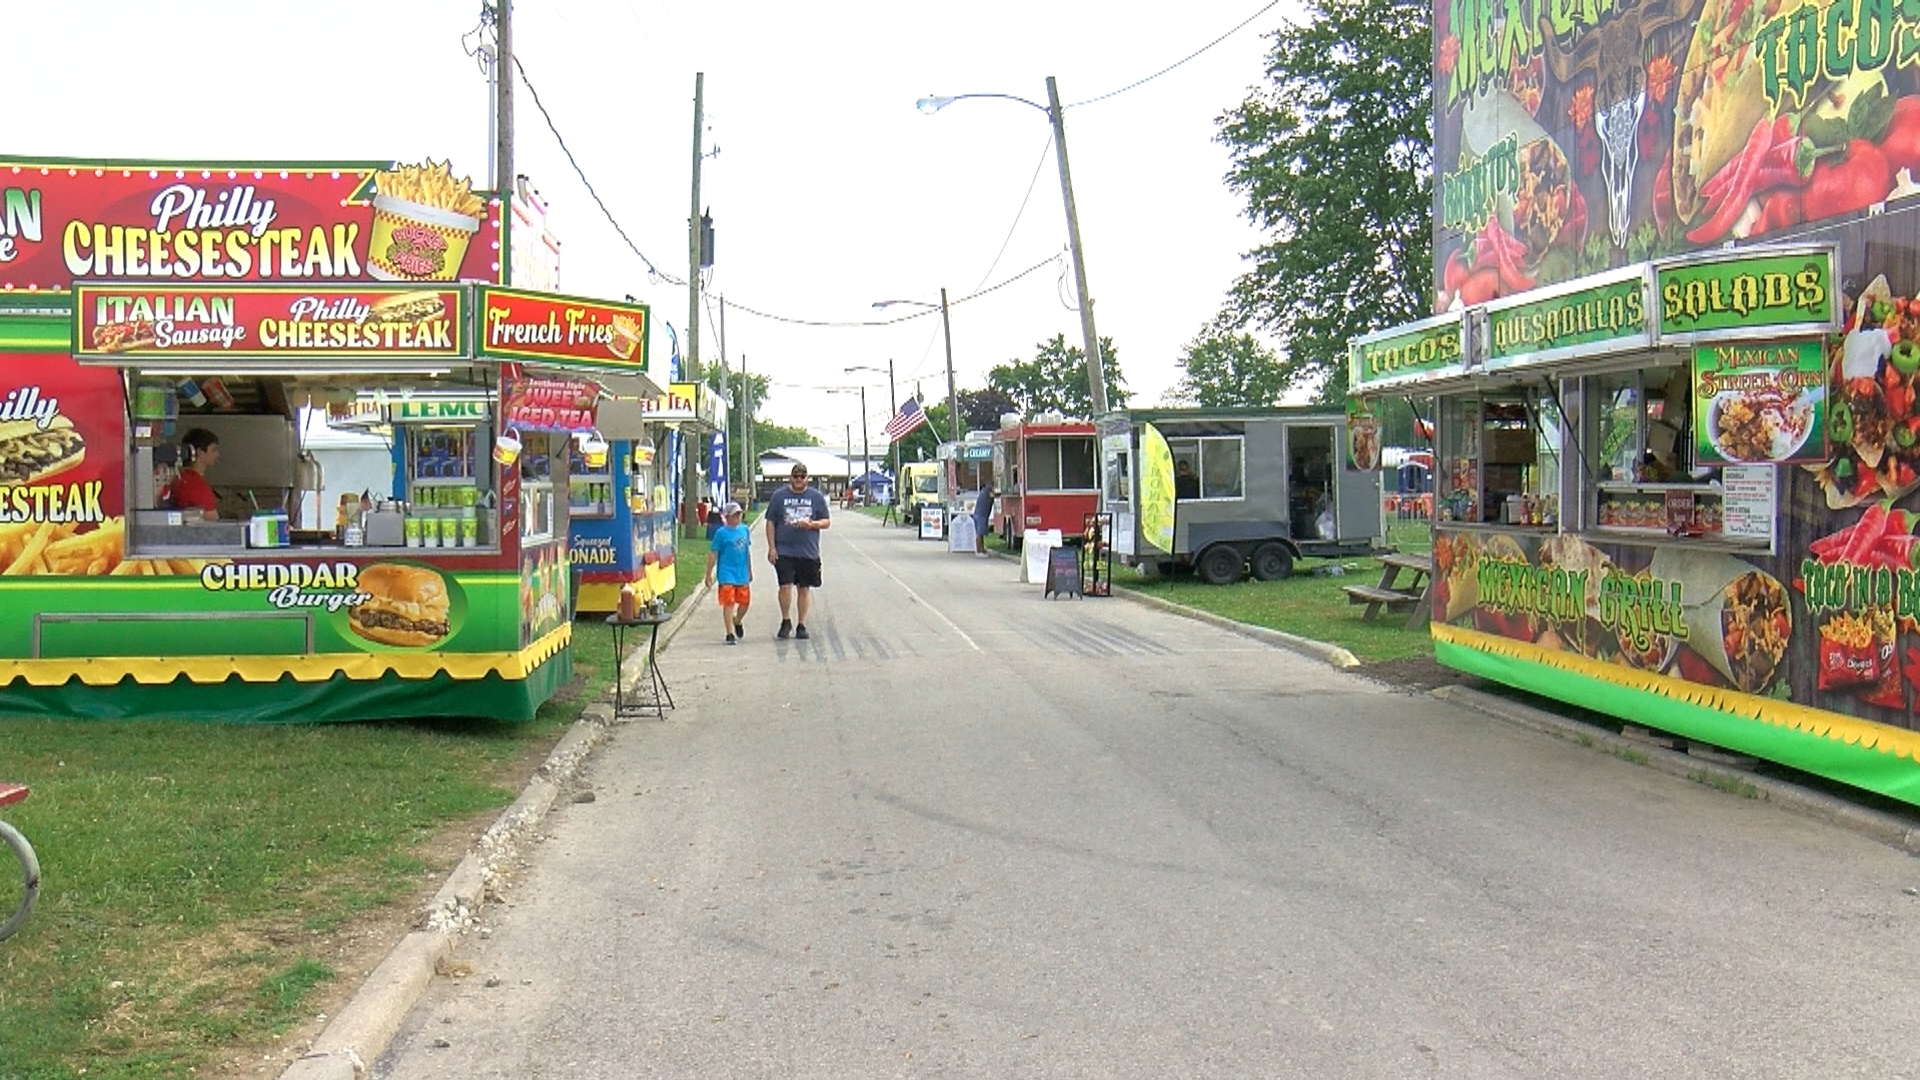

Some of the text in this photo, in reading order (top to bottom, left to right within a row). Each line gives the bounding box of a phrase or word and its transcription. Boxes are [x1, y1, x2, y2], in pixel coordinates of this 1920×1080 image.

[0, 188, 42, 242] N
[150, 184, 277, 237] Philly
[62, 220, 361, 278] CHEESESTEAK
[1662, 263, 1825, 325] SALADS
[95, 296, 235, 326] ITALIAN
[289, 297, 371, 323] Philly
[1495, 290, 1645, 354] QUESADILLAS
[154, 320, 247, 348] Sausage
[259, 318, 452, 348] CHEESESTEAK
[489, 306, 614, 345] French Fries
[1366, 331, 1461, 375] TACOS
[1714, 346, 1800, 372] MEXICAN
[524, 387, 584, 407] SWEET
[529, 378, 586, 390] Southern Style
[0, 386, 59, 428] illy
[512, 406, 593, 429] ICED TEA
[574, 534, 612, 548] Squeezed
[201, 562, 359, 590] CHEDDAR
[1802, 559, 1851, 616] TACO
[267, 585, 372, 612] Burger
[1476, 558, 1690, 652] MEXICAN GRILL
[1847, 657, 1873, 670] Doritos
